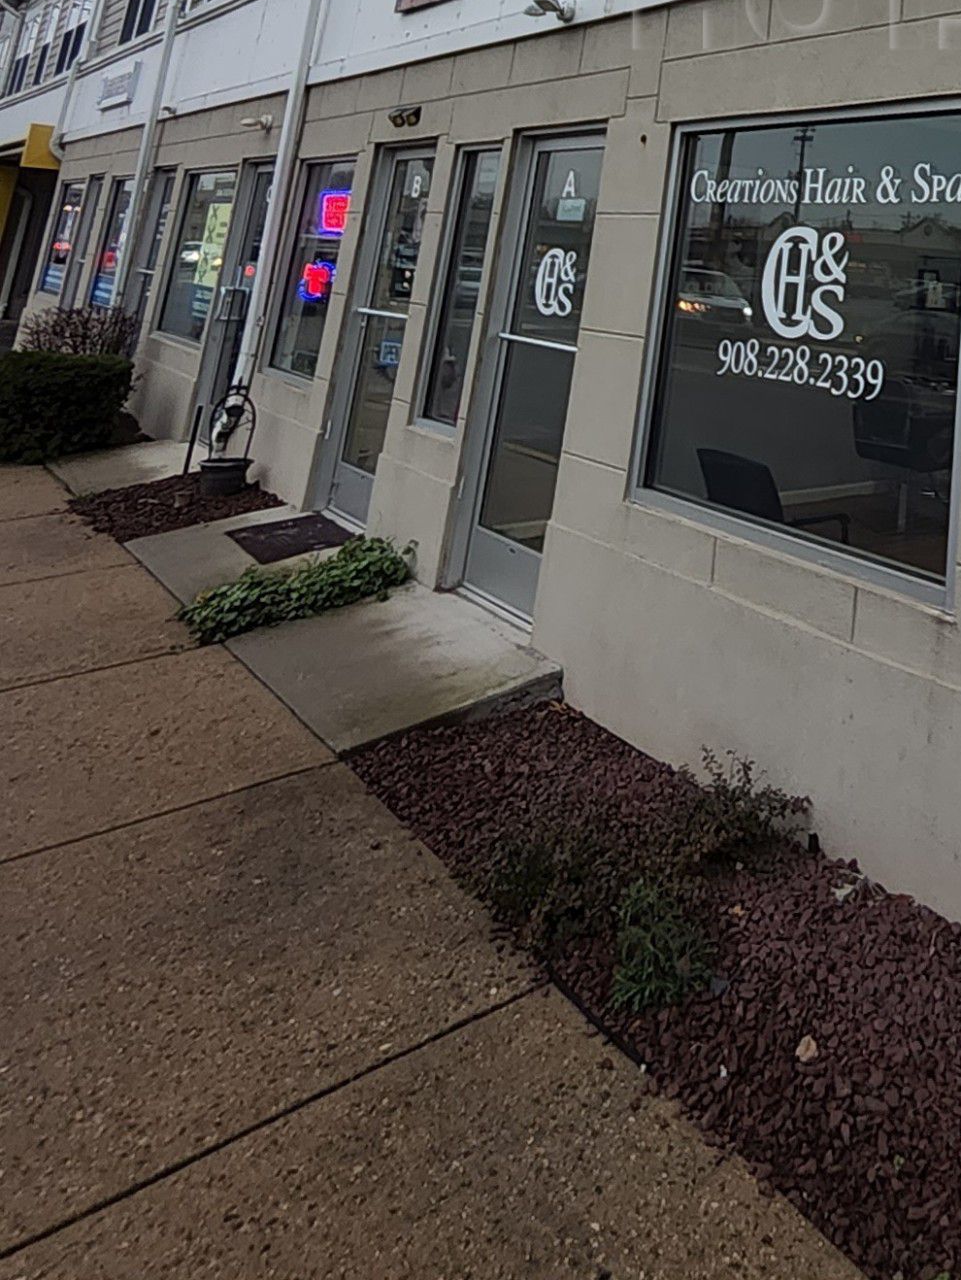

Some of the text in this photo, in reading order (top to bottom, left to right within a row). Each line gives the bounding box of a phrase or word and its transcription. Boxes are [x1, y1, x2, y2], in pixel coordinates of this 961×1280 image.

[411, 175, 422, 198] B
[562, 170, 576, 198] A
[876, 165, 902, 204] &
[716, 338, 884, 401] 908.228.2339
